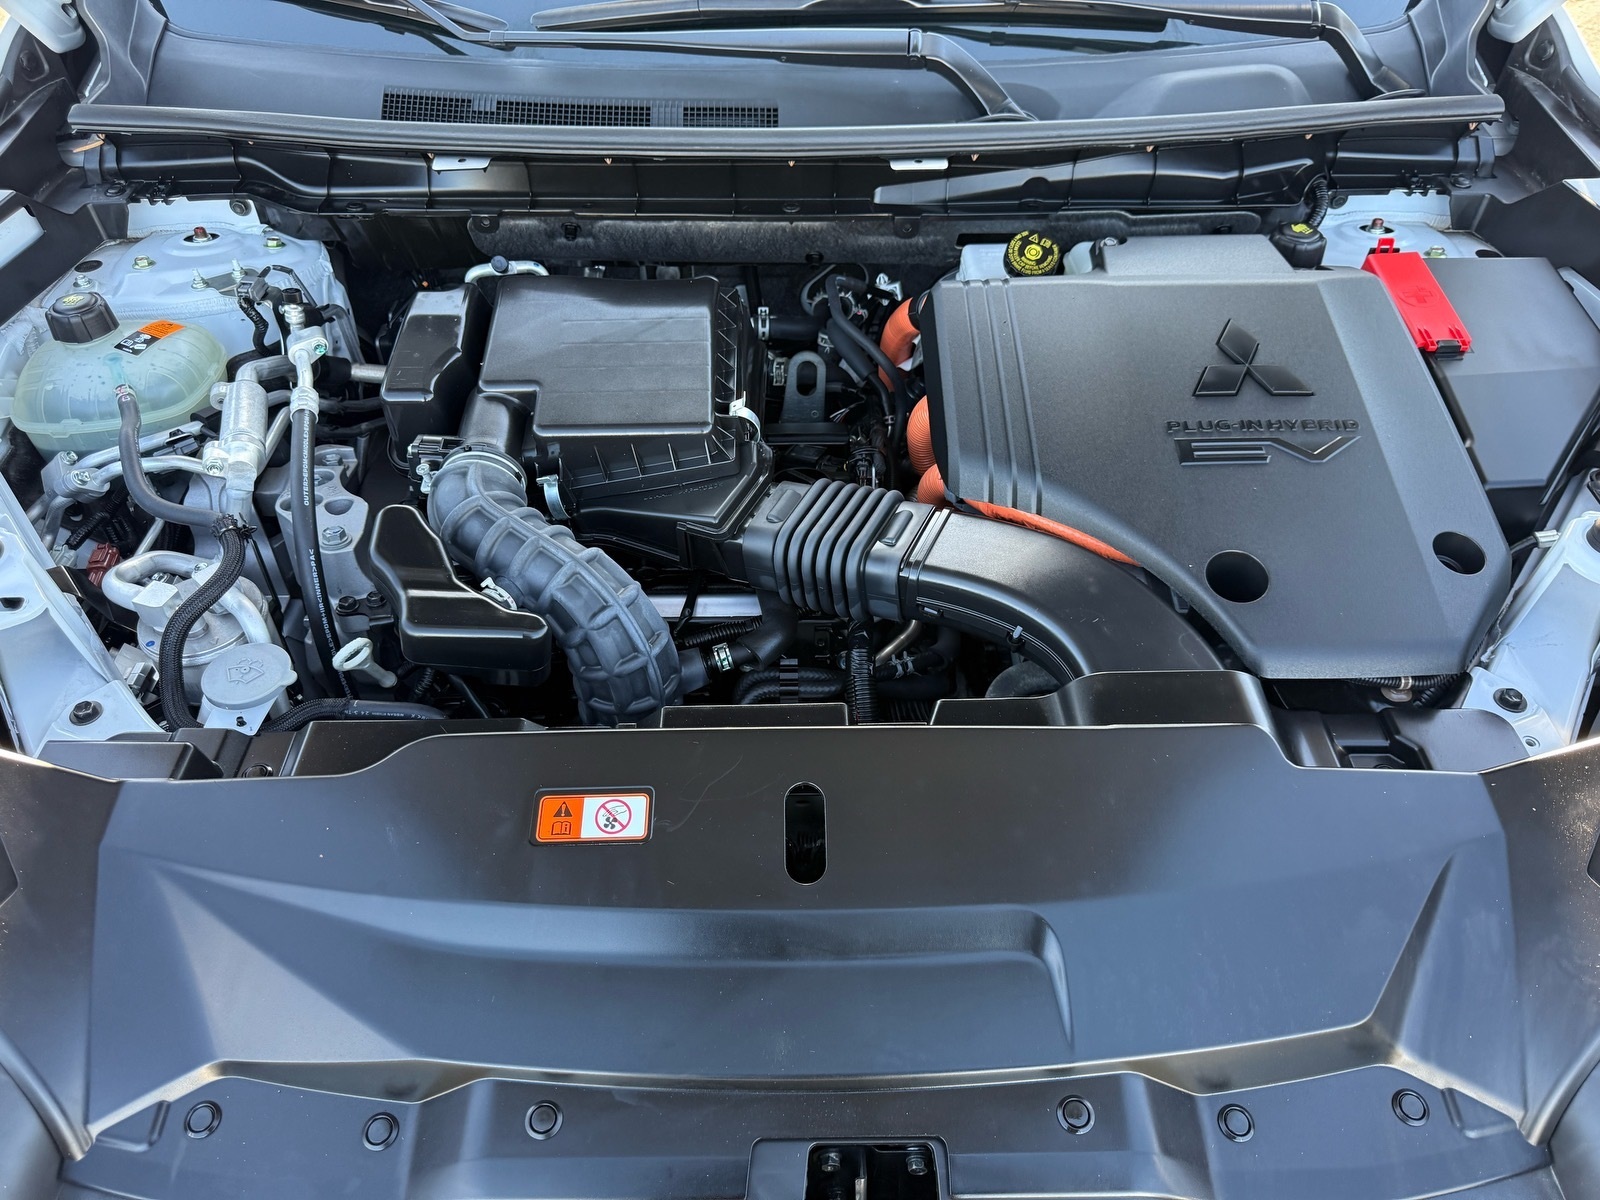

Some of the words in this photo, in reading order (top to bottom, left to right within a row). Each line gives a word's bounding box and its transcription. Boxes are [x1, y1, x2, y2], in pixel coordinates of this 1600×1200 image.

[1166, 419, 1265, 433] PLUG-IN
[1267, 418, 1361, 432] HYBRID
[1174, 435, 1362, 466] EV
